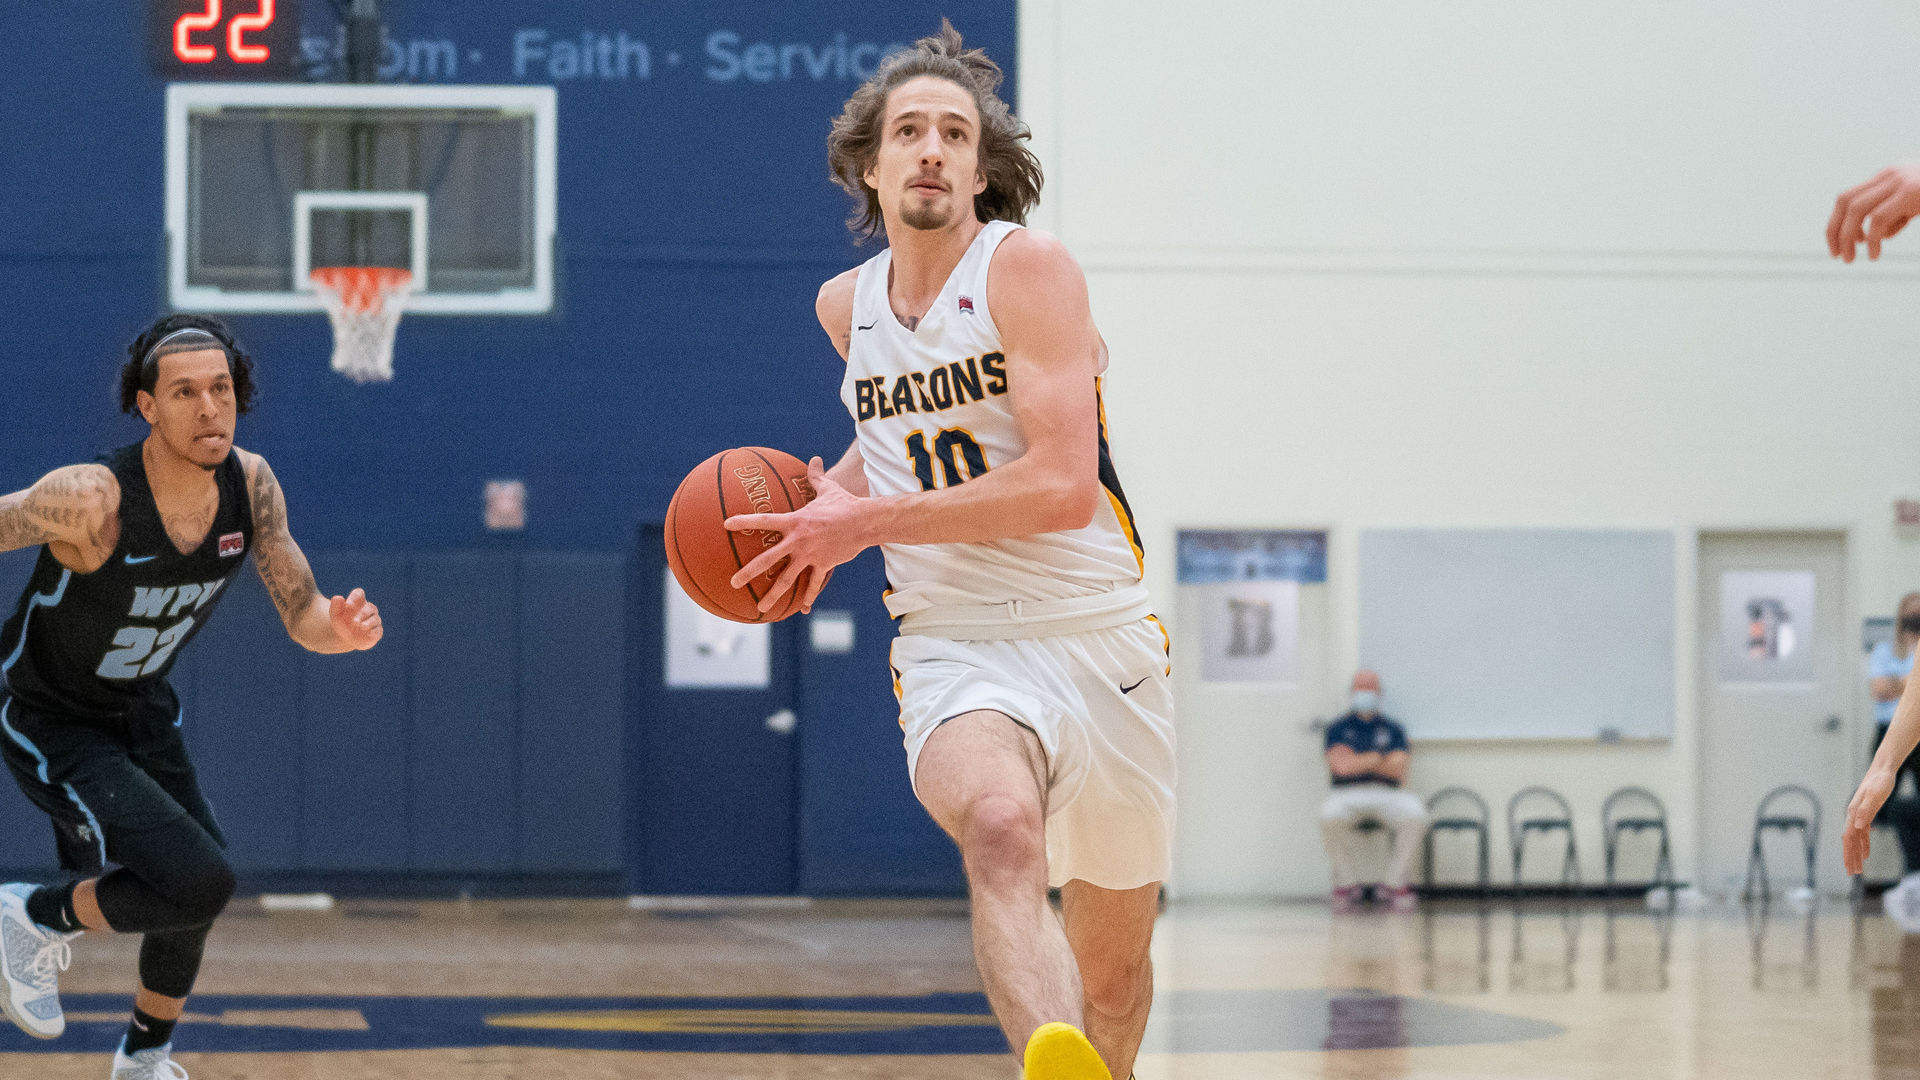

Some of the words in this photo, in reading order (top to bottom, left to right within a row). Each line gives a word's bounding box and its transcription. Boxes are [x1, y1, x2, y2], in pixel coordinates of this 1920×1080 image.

[173, 0, 275, 63] 22
[513, 28, 650, 78] Faith
[855, 350, 1008, 423] BEACONS
[904, 426, 990, 492] 10
[95, 615, 195, 679] 22
